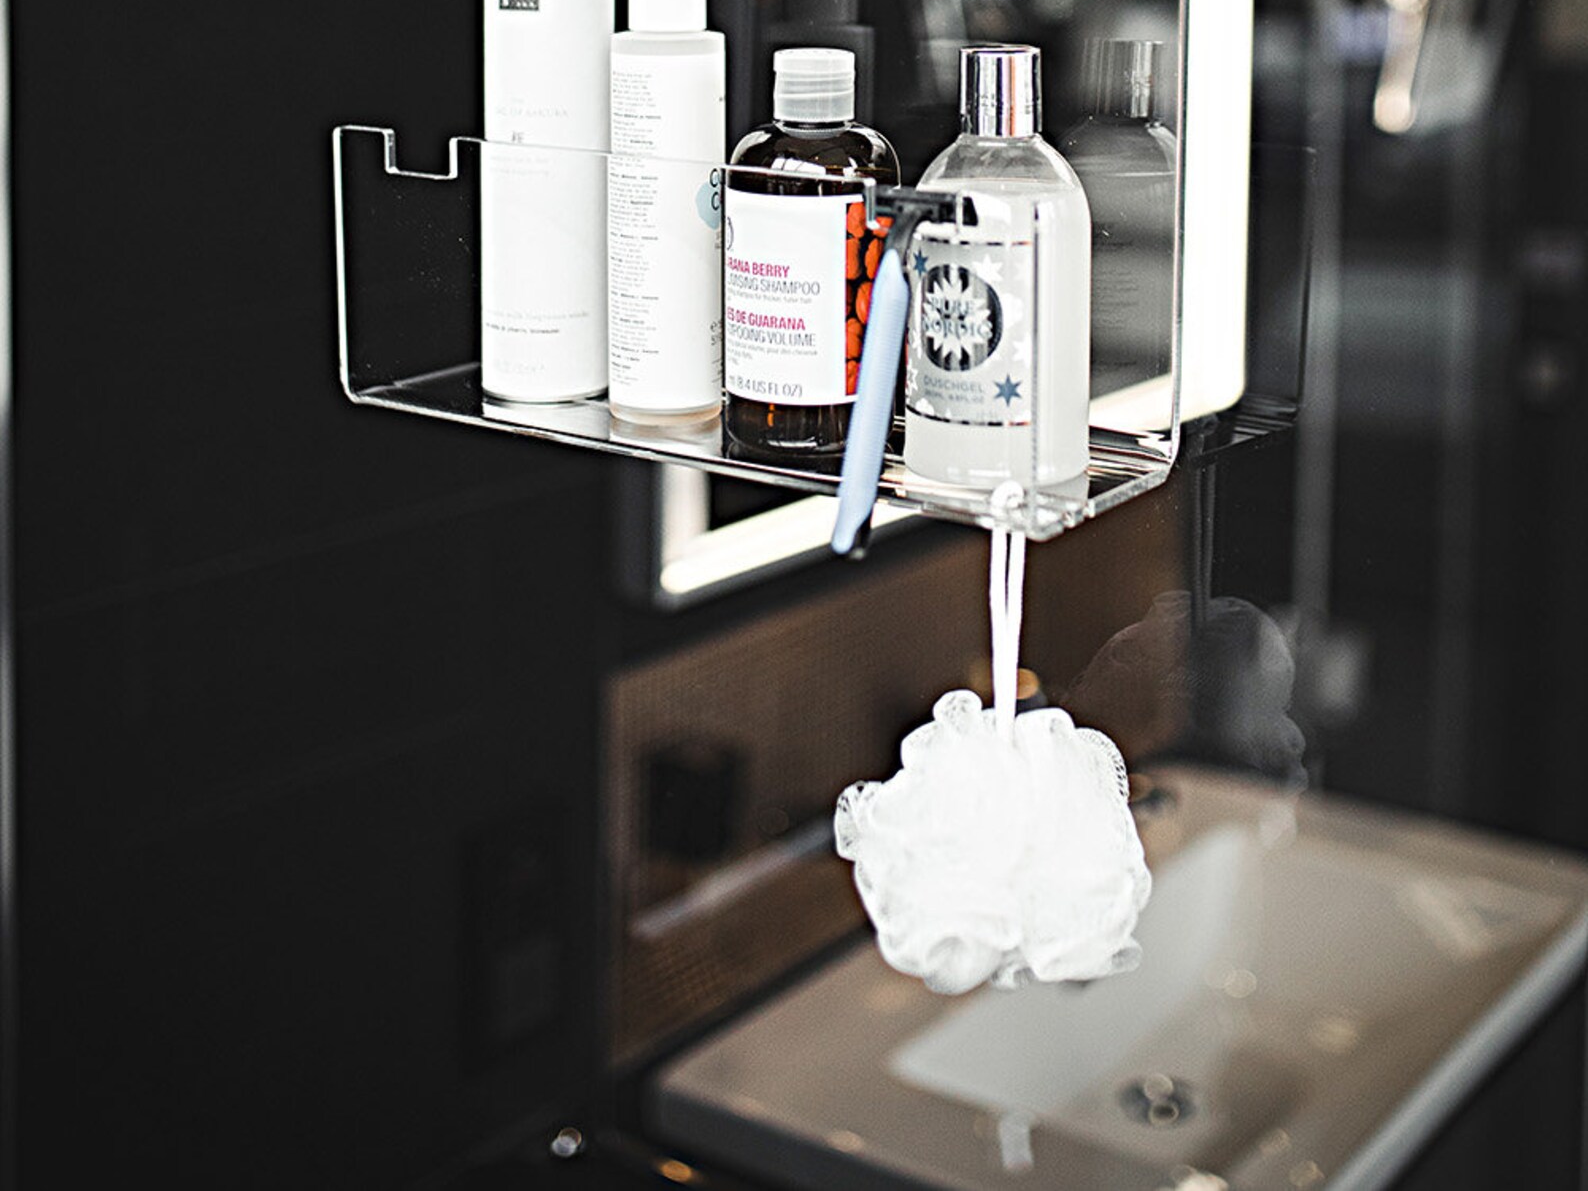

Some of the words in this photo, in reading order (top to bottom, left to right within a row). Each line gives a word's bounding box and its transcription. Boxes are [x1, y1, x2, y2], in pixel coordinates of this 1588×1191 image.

[752, 262, 790, 279] BERRY
[760, 278, 821, 296] SHAMPOO
[931, 296, 974, 316] PURE
[736, 309, 747, 325] DE
[748, 312, 806, 331] GUARANA
[922, 315, 993, 340] NORDIC
[766, 330, 817, 348] VOLUME
[923, 376, 984, 391] DUSCHGEL
